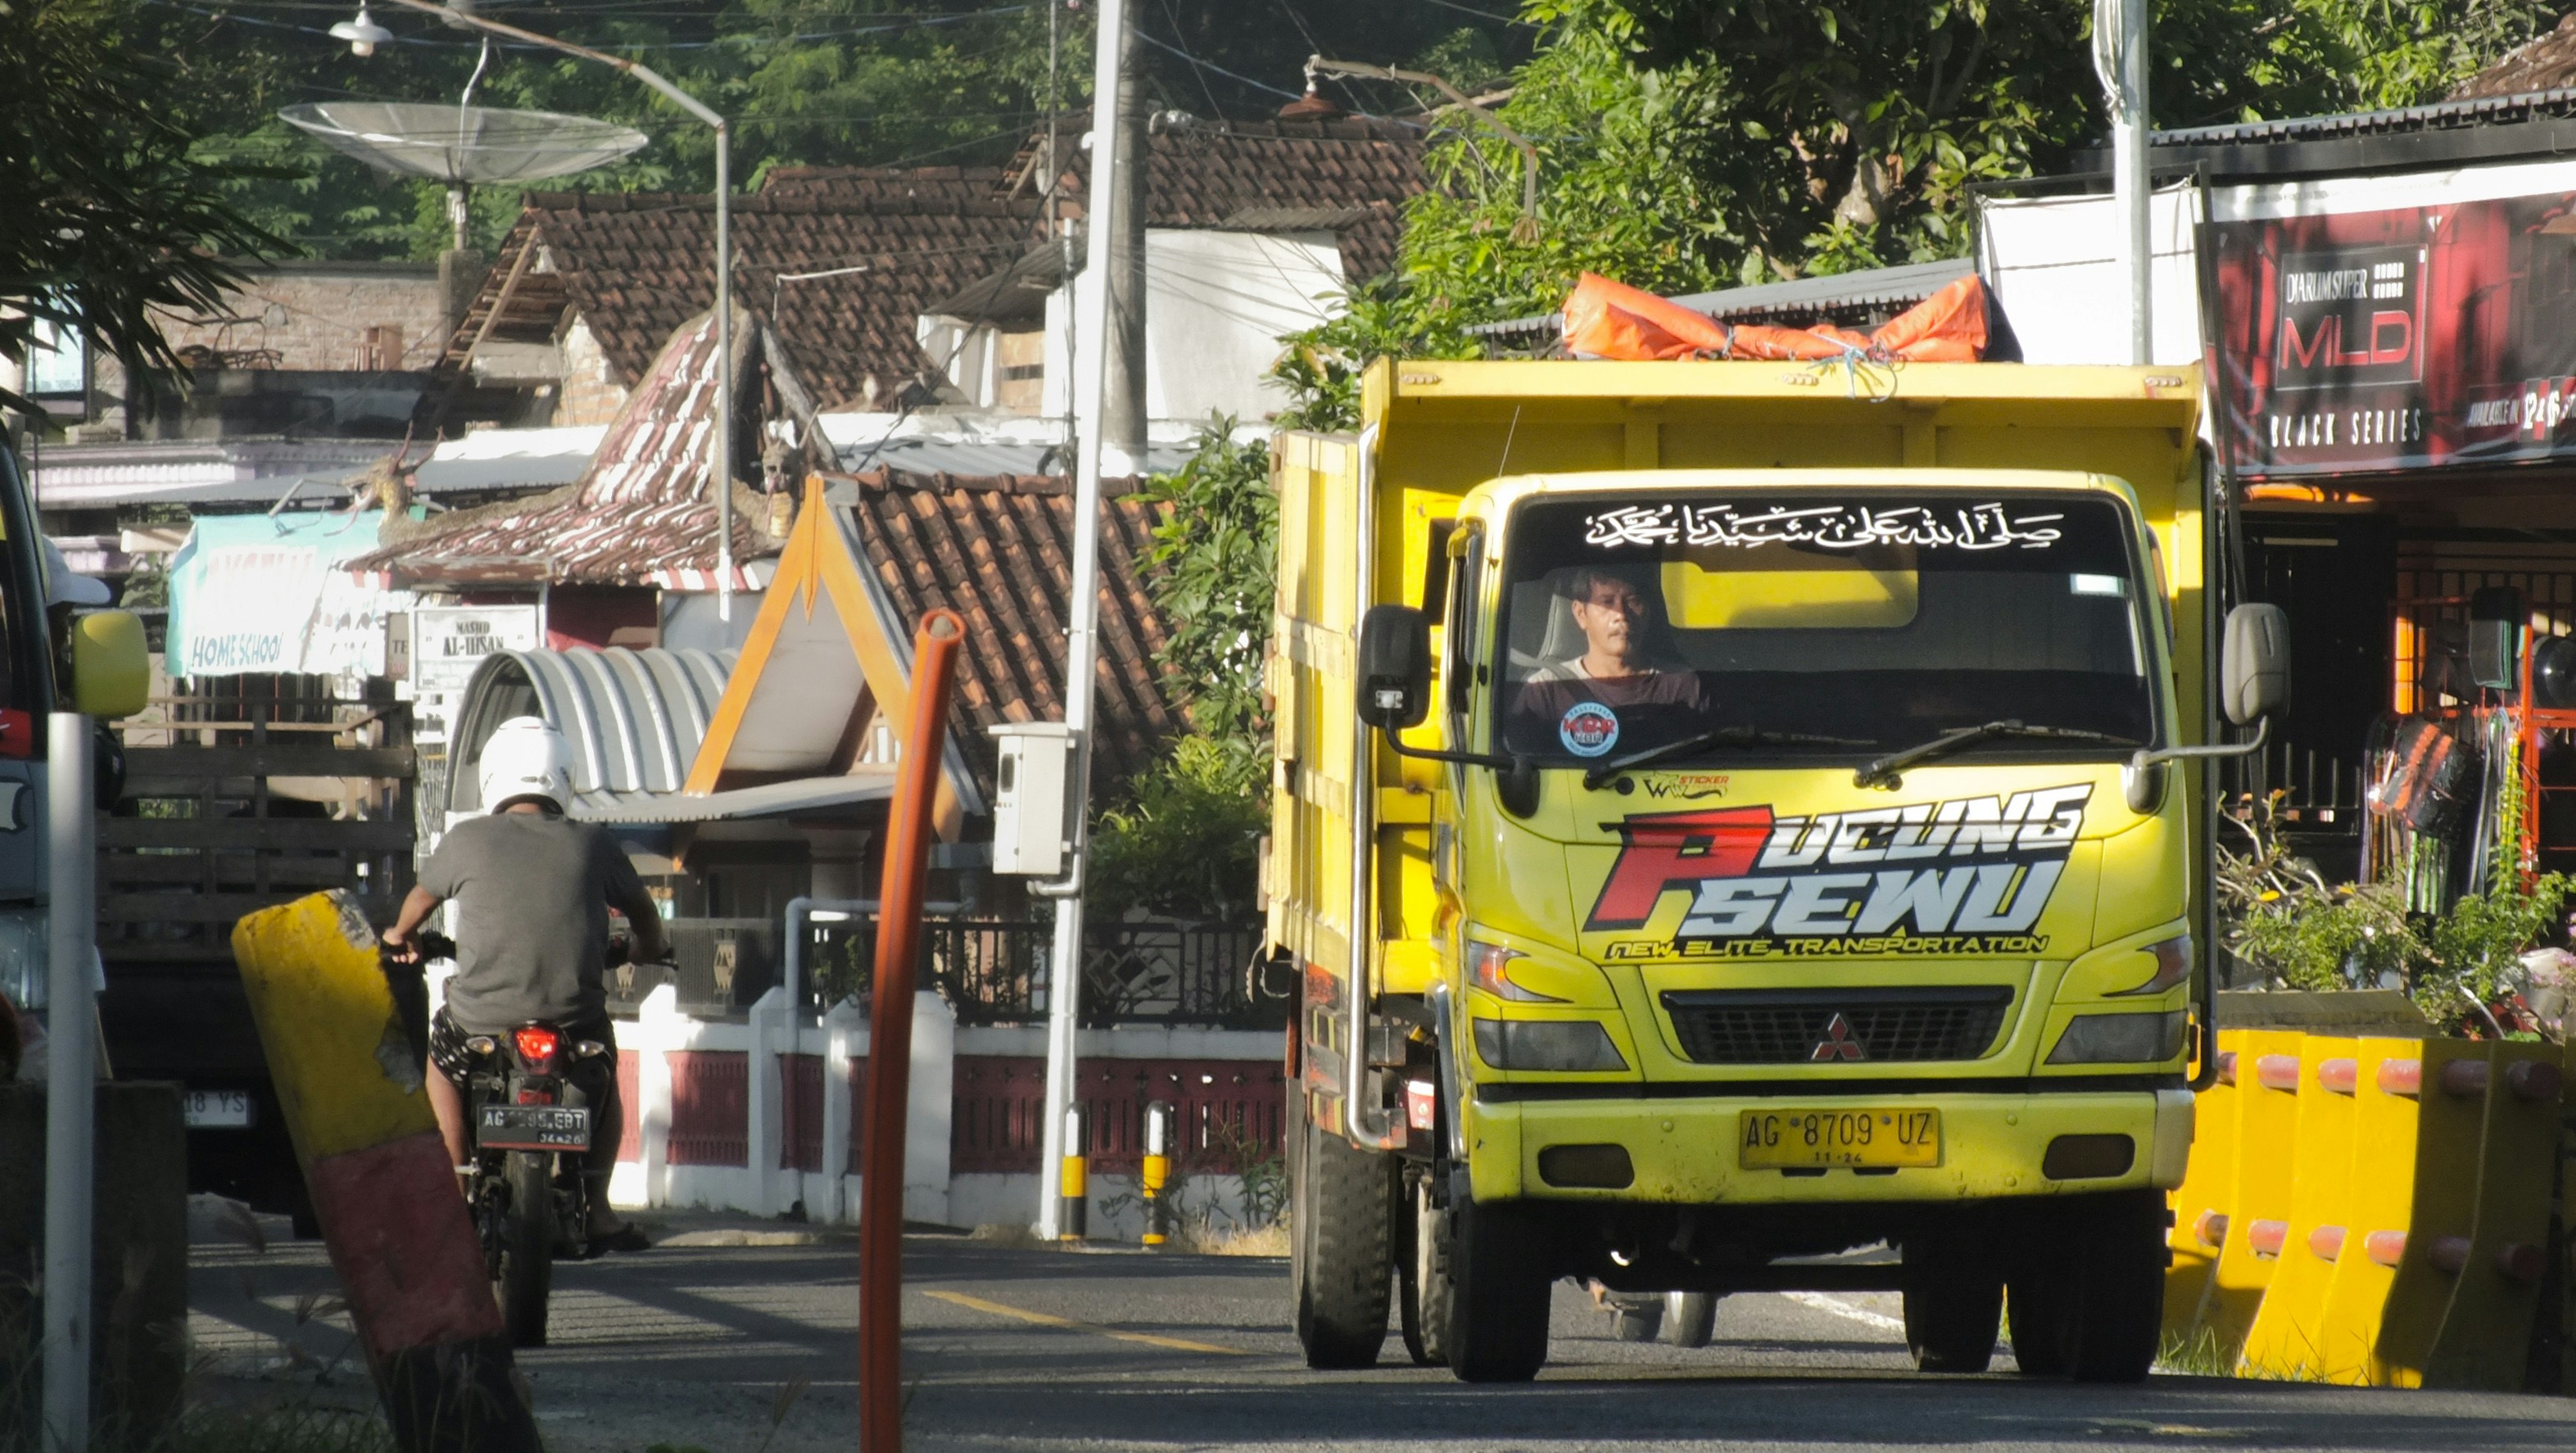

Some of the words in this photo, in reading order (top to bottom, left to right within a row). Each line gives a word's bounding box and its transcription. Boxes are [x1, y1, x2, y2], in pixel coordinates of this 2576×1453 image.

[2282, 310, 2411, 369] MLD
[2270, 413, 2335, 448] BLACK
[2351, 408, 2421, 446] SERIES
[1679, 776, 1730, 785] STICKER
[1677, 860, 2065, 936] SEWU
[1608, 940, 1675, 958] NEW
[1683, 939, 1772, 957] ELITE
[1784, 936, 2049, 953] TRANSPORTATION
[484, 1111, 505, 1127] AG
[1746, 1115, 1779, 1147] AG
[1804, 1113, 1872, 1146] 8709
[1899, 1112, 1931, 1144] UZ
